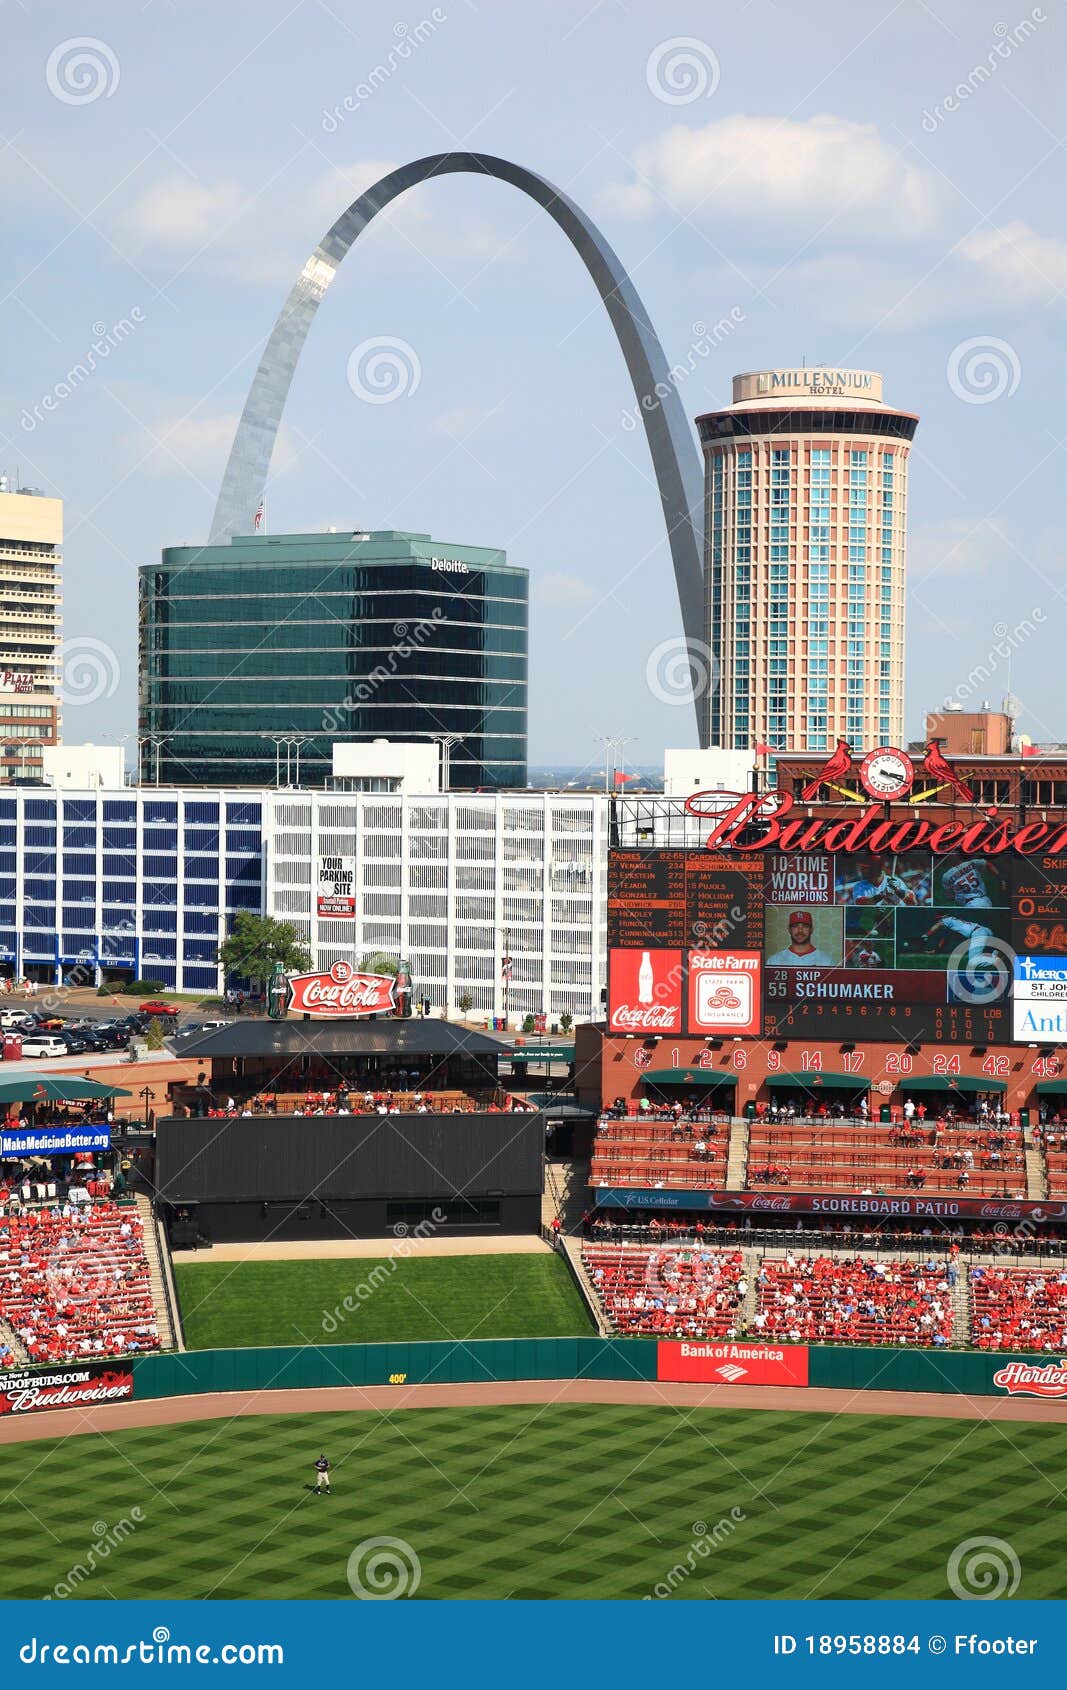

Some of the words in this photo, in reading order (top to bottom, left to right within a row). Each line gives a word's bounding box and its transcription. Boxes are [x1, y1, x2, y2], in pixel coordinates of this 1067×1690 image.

[772, 372, 872, 389] MILLENNIUM
[809, 386, 844, 395] HOTEL
[431, 557, 469, 574] Deloitte.
[4, 671, 34, 686] PLAZA
[686, 790, 1067, 851] Budweiser
[322, 857, 343, 870] YOUR
[610, 851, 641, 860] PADRES
[688, 853, 733, 861] CARDINALS
[771, 855, 829, 872] 10-TIME
[319, 870, 353, 882] PARKING
[699, 873, 712, 881] JAY
[771, 872, 829, 890] WORLD
[334, 883, 351, 895] SITE
[698, 882, 727, 890] PUJOLS
[771, 890, 829, 902] CHAMPIONS
[698, 902, 729, 910] RASMUS
[697, 911, 728, 919] MOLINA
[619, 939, 645, 947] YOUNG
[691, 955, 725, 969] State
[725, 956, 759, 969] Farm
[774, 970, 789, 981] 2B
[795, 971, 821, 982] SKIP
[302, 979, 382, 1008] Coca-Cola
[768, 983, 788, 998] 55
[795, 983, 895, 999] SCHUMAKER
[612, 1004, 679, 1028] Coca-Cola
[1019, 1008, 1067, 1033] Ant
[671, 1047, 680, 1068] 1
[698, 1048, 714, 1069] 2
[733, 1049, 748, 1070] 6
[767, 1050, 781, 1071] 9
[800, 1050, 823, 1072] 14
[842, 1051, 865, 1073] 17
[885, 1052, 914, 1073] 20
[932, 1053, 961, 1075] 24
[982, 1055, 1011, 1076] 42
[1031, 1055, 1060, 1078] 45
[3, 1134, 109, 1152] MakeMedicineBetter.org
[812, 1199, 911, 1214] SCOREBOARD
[915, 1201, 960, 1216] PATIO
[680, 1343, 714, 1357] Bank
[715, 1345, 729, 1359] of
[730, 1346, 784, 1361] America
[7, 1383, 131, 1412] Budweiser
